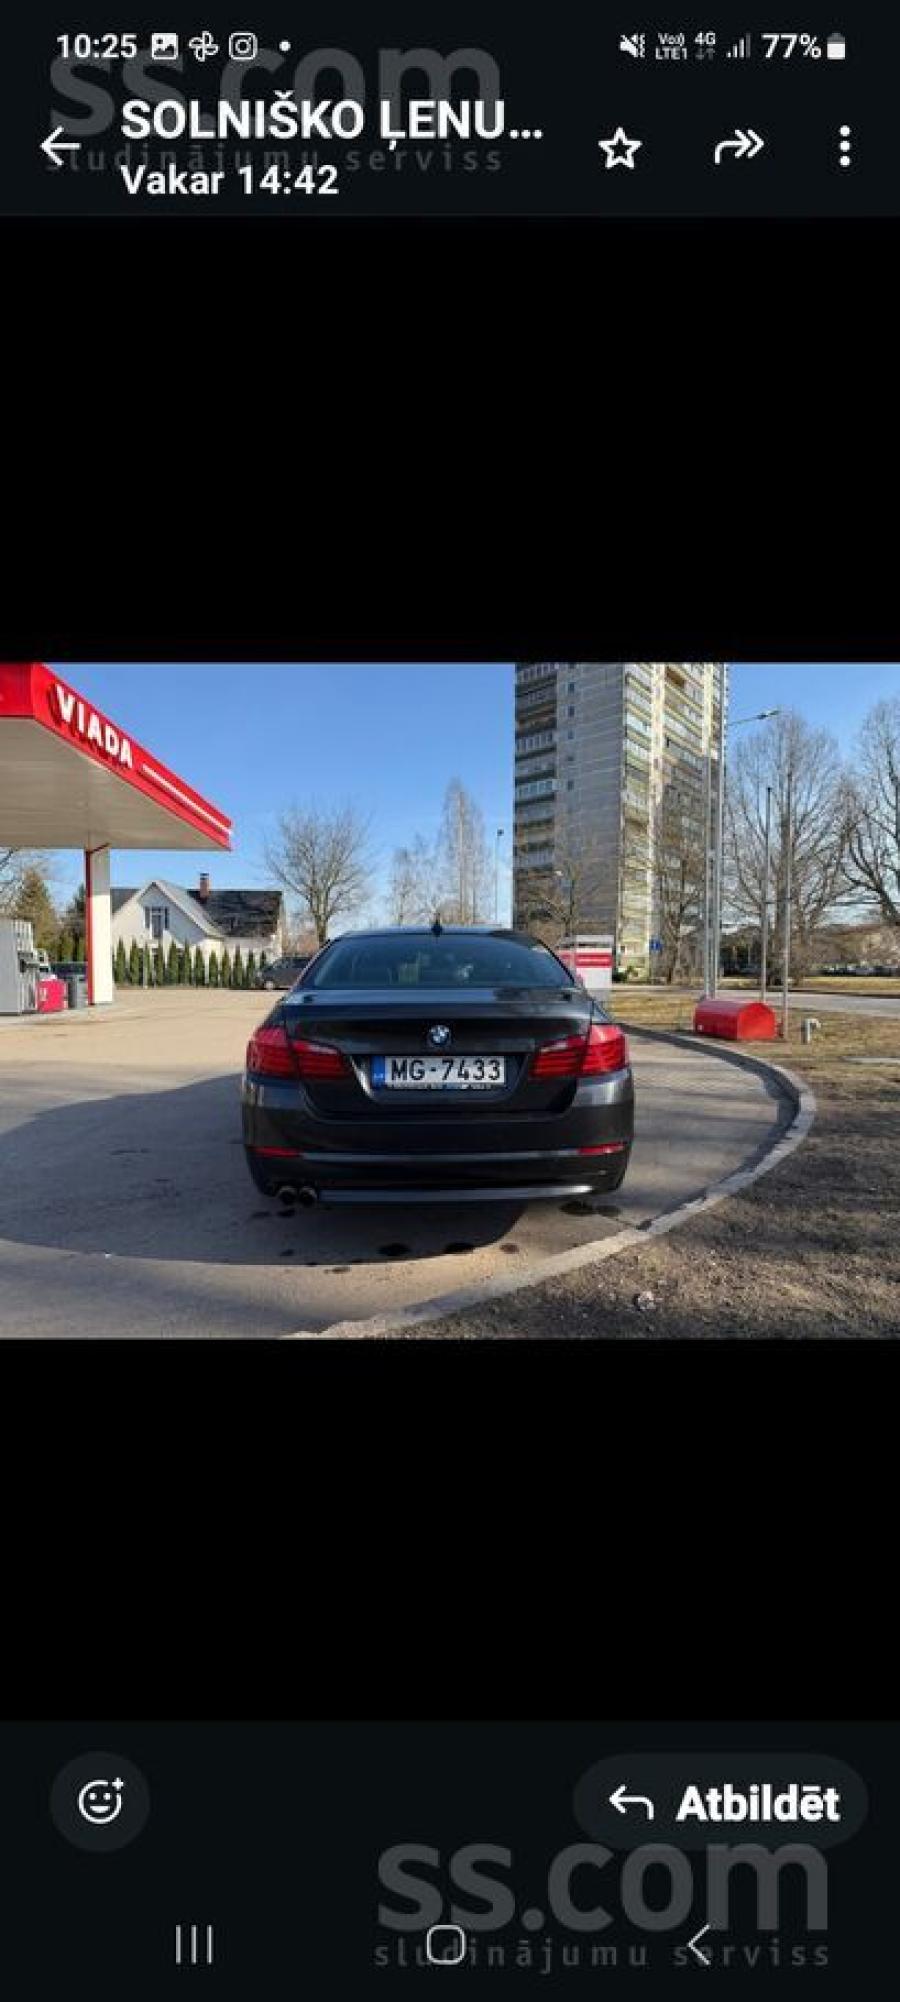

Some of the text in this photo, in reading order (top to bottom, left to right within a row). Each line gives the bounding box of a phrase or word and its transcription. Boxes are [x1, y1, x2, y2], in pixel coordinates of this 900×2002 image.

[56, 33, 138, 59] 10:25
[694, 31, 717, 45] 4G
[761, 33, 822, 60] 77%
[655, 47, 687, 60] LTE1
[121, 90, 365, 140] SOLNIŠKO
[121, 163, 340, 195] Vakar 14:42
[55, 683, 133, 769] VIADA
[390, 1058, 501, 1081] MG-7433
[676, 1783, 841, 1822] Atbildēt
